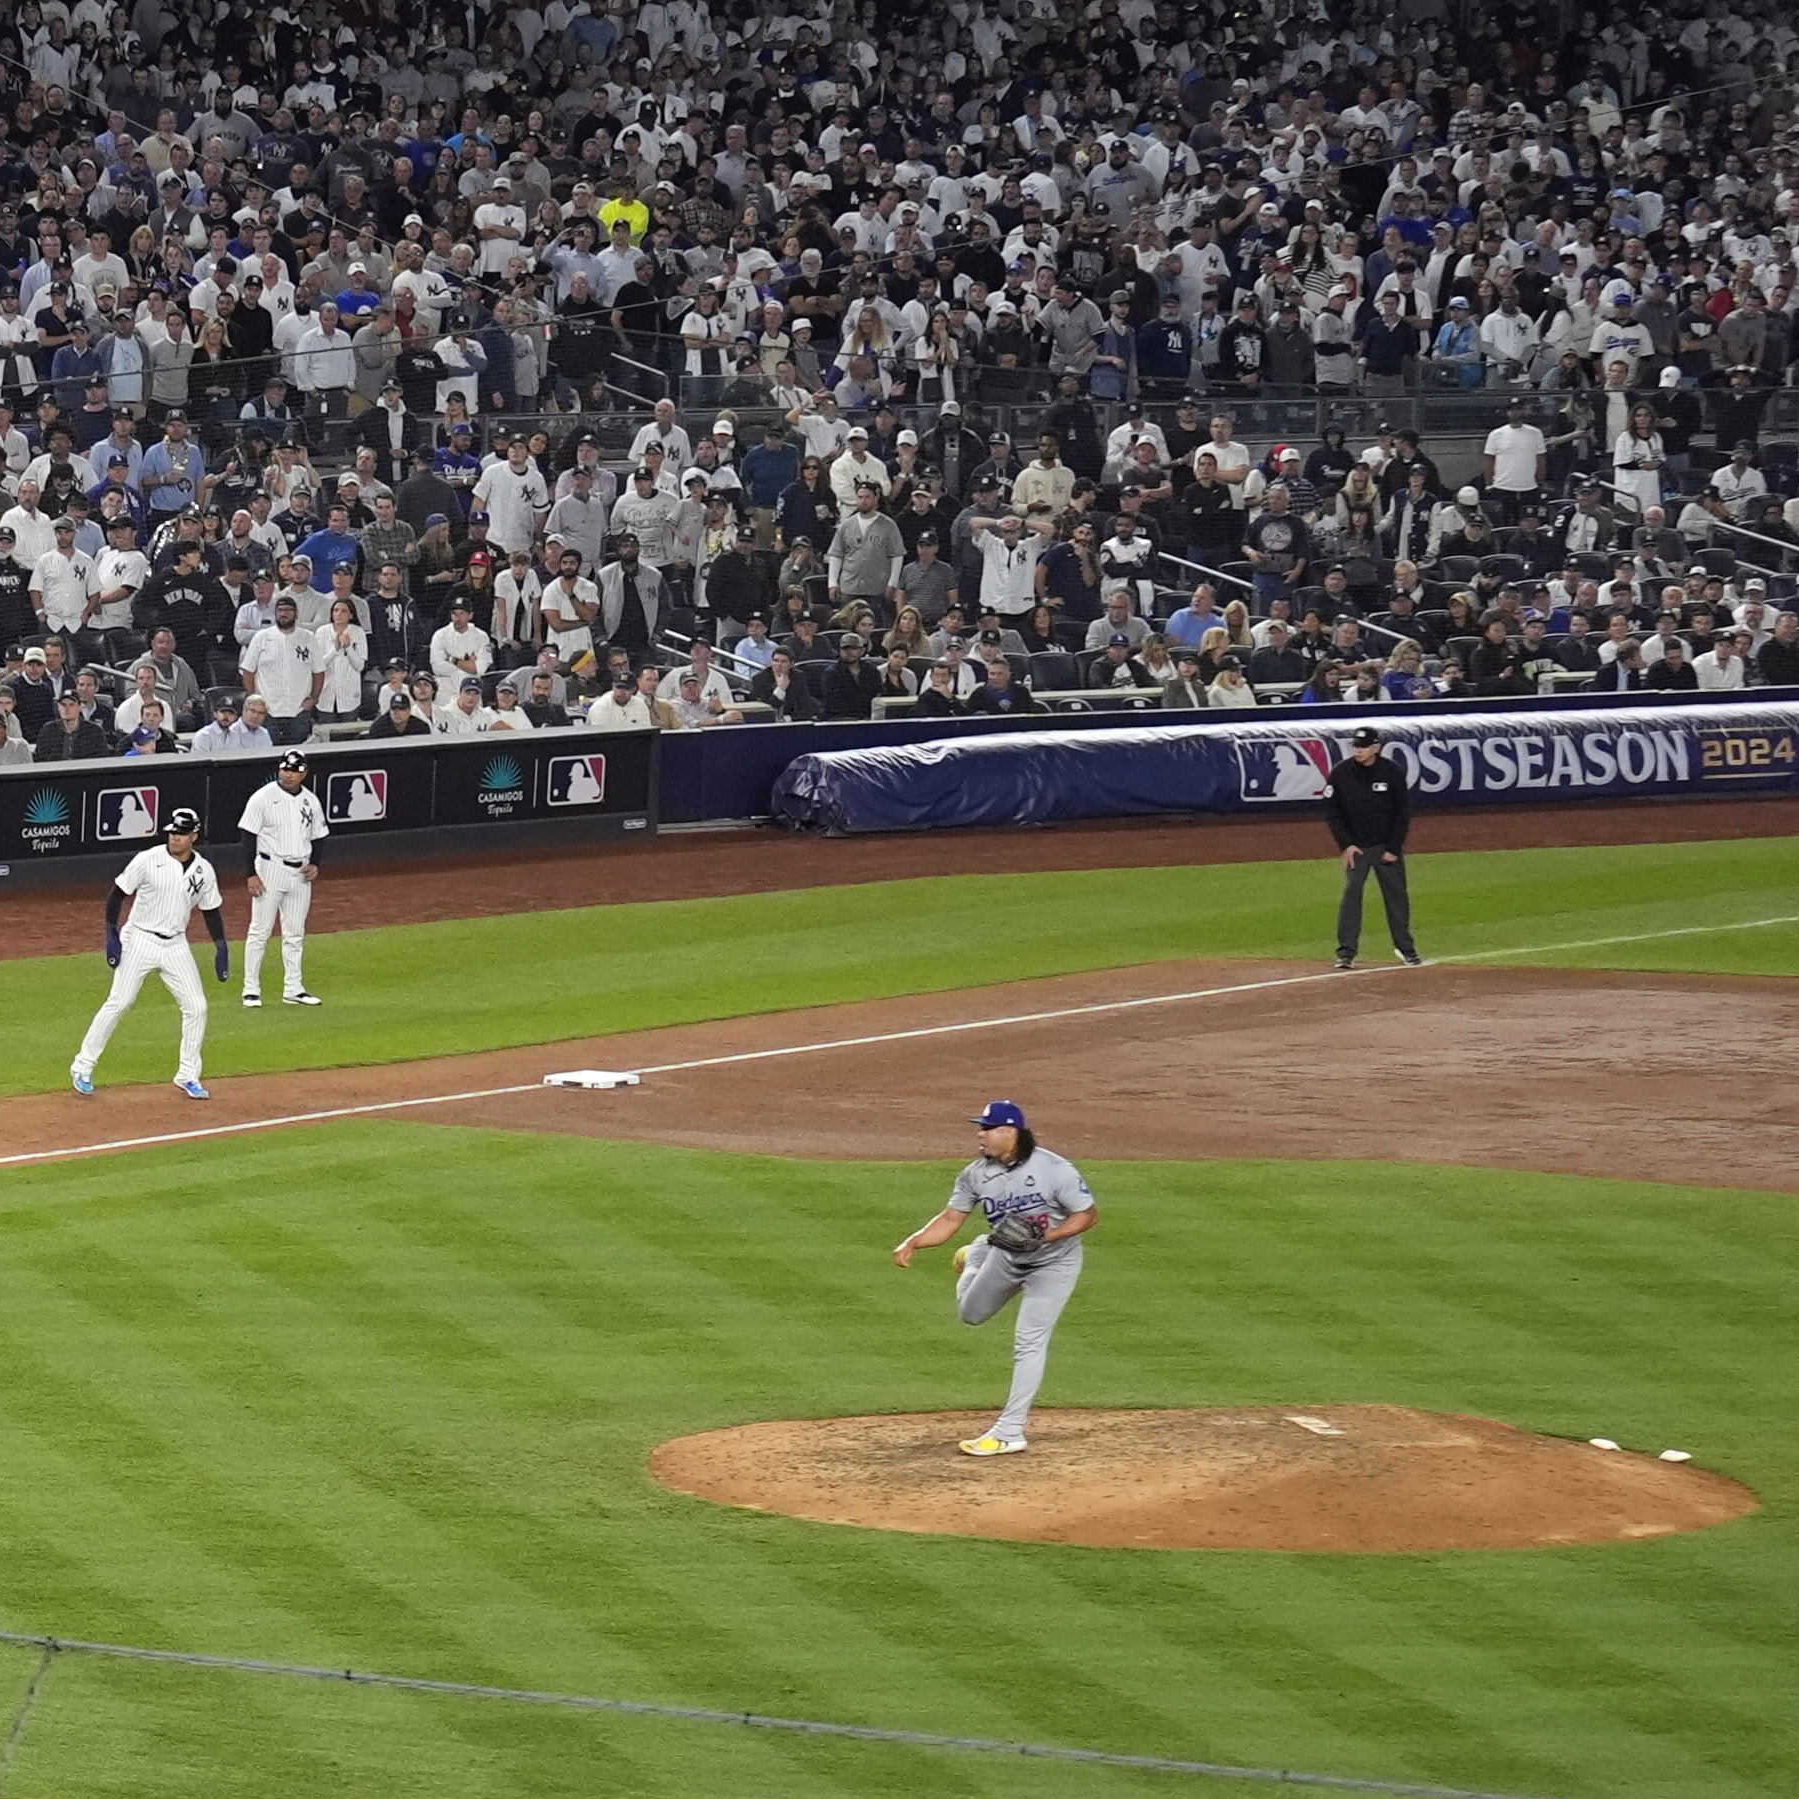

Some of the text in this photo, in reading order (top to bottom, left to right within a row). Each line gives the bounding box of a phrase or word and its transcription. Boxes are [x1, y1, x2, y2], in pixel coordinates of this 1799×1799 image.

[1555, 515, 1563, 528] 2
[1335, 728, 1794, 793] OSTSEASON 2024
[478, 790, 524, 804] CASAMIGOS
[300, 805, 313, 827] NY
[487, 803, 514, 817] Tequila
[21, 825, 71, 839] CASAMIGOS
[32, 838, 60, 853] Tequila
[187, 875, 204, 897] NY
[985, 1190, 1046, 1216] Dodgers
